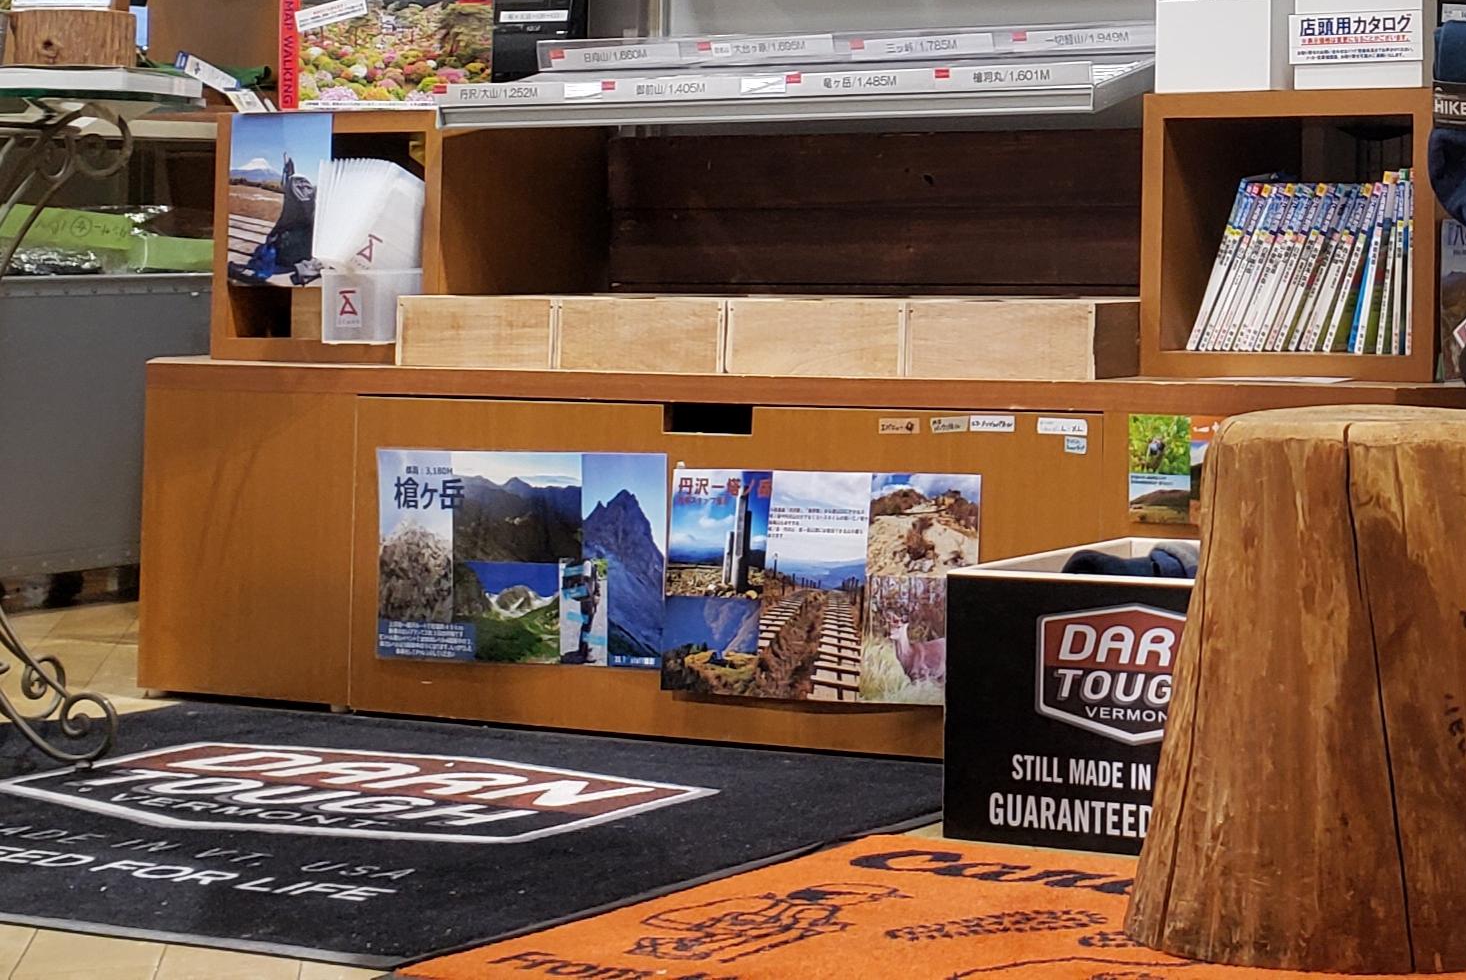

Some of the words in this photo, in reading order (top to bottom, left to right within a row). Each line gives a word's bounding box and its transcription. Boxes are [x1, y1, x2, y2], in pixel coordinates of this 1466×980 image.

[1299, 13, 1413, 36] 店頭用カタログ
[282, 36, 295, 106] WALKING
[1058, 624, 1176, 667] DAR
[1055, 669, 1172, 705] TOUG
[1085, 705, 1167, 723] VERMON
[167, 751, 657, 808] DARN
[1011, 753, 1063, 784] STILL
[1069, 758, 1124, 789] MADE
[1130, 762, 1152, 792] IN
[91, 769, 540, 827] TOUGH
[108, 792, 389, 831] VERMONT
[989, 791, 1152, 839] GUARANTEED
[0, 825, 106, 845] ADE
[110, 838, 183, 853] IN
[299, 860, 417, 881] USA
[89, 859, 240, 886] FOR
[233, 876, 400, 903] LIFE
